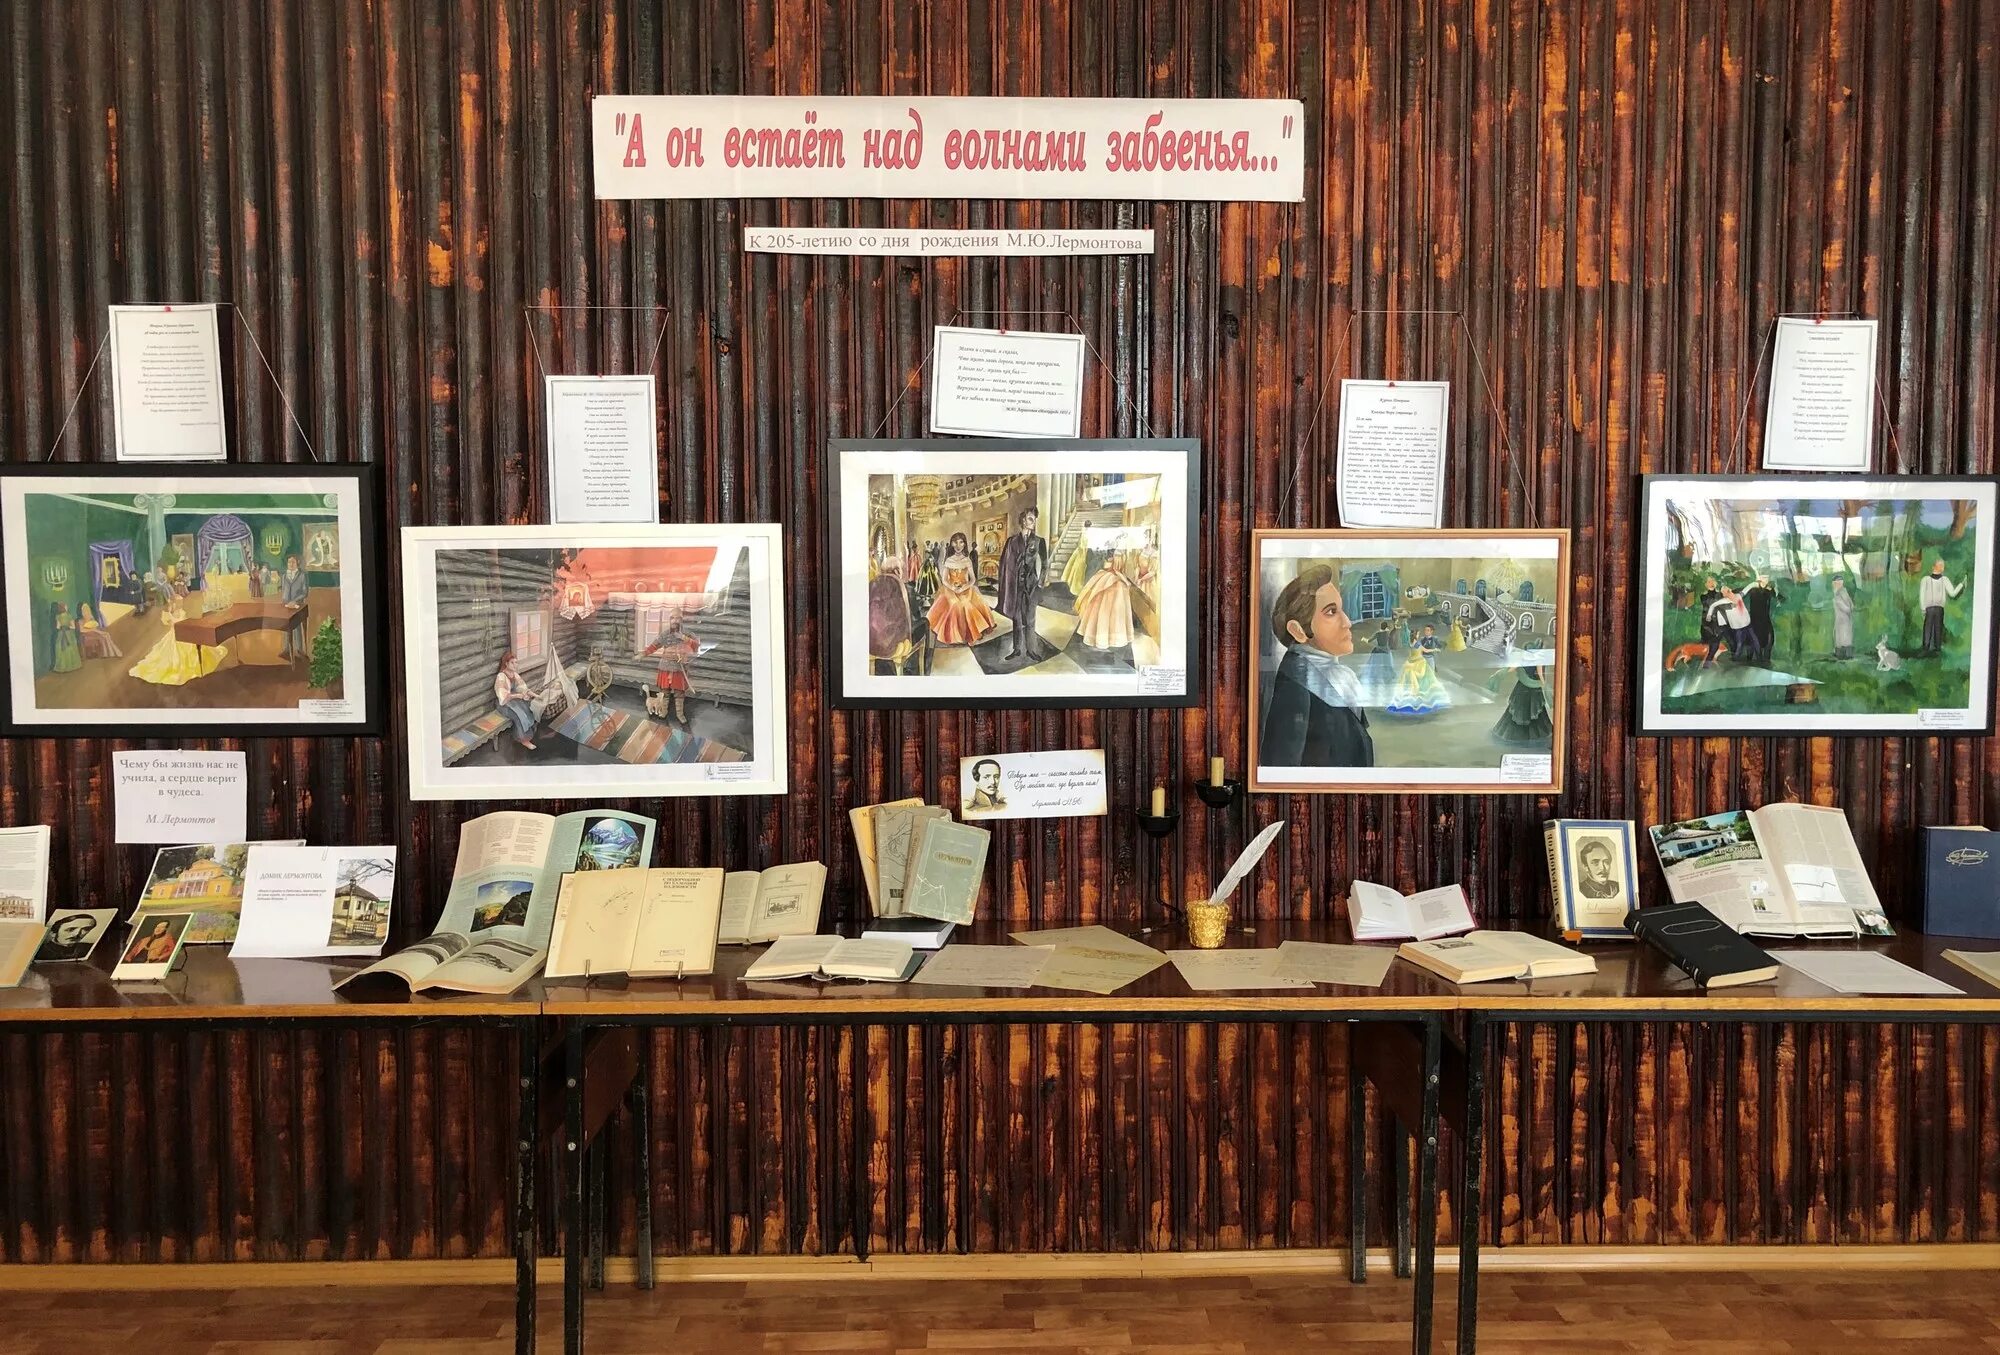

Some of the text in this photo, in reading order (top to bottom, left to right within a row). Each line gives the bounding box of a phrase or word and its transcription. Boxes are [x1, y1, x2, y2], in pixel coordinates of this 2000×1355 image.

[615, 112, 648, 168] "А
[666, 129, 705, 169] он
[724, 110, 846, 169] встаёт
[864, 108, 925, 171] над
[944, 129, 1088, 172] волнами
[749, 233, 1143, 250] К 205-летию со дня рождения М.Ю.Лермонтова
[120, 759, 239, 771] Чему бы жизнь нас не
[122, 775, 238, 785] учила, а сердце верит
[167, 788, 204, 799] чудеса.
[145, 814, 216, 826] М. Лермонтов
[283, 872, 323, 880] ЛЕРМОНТОВА
